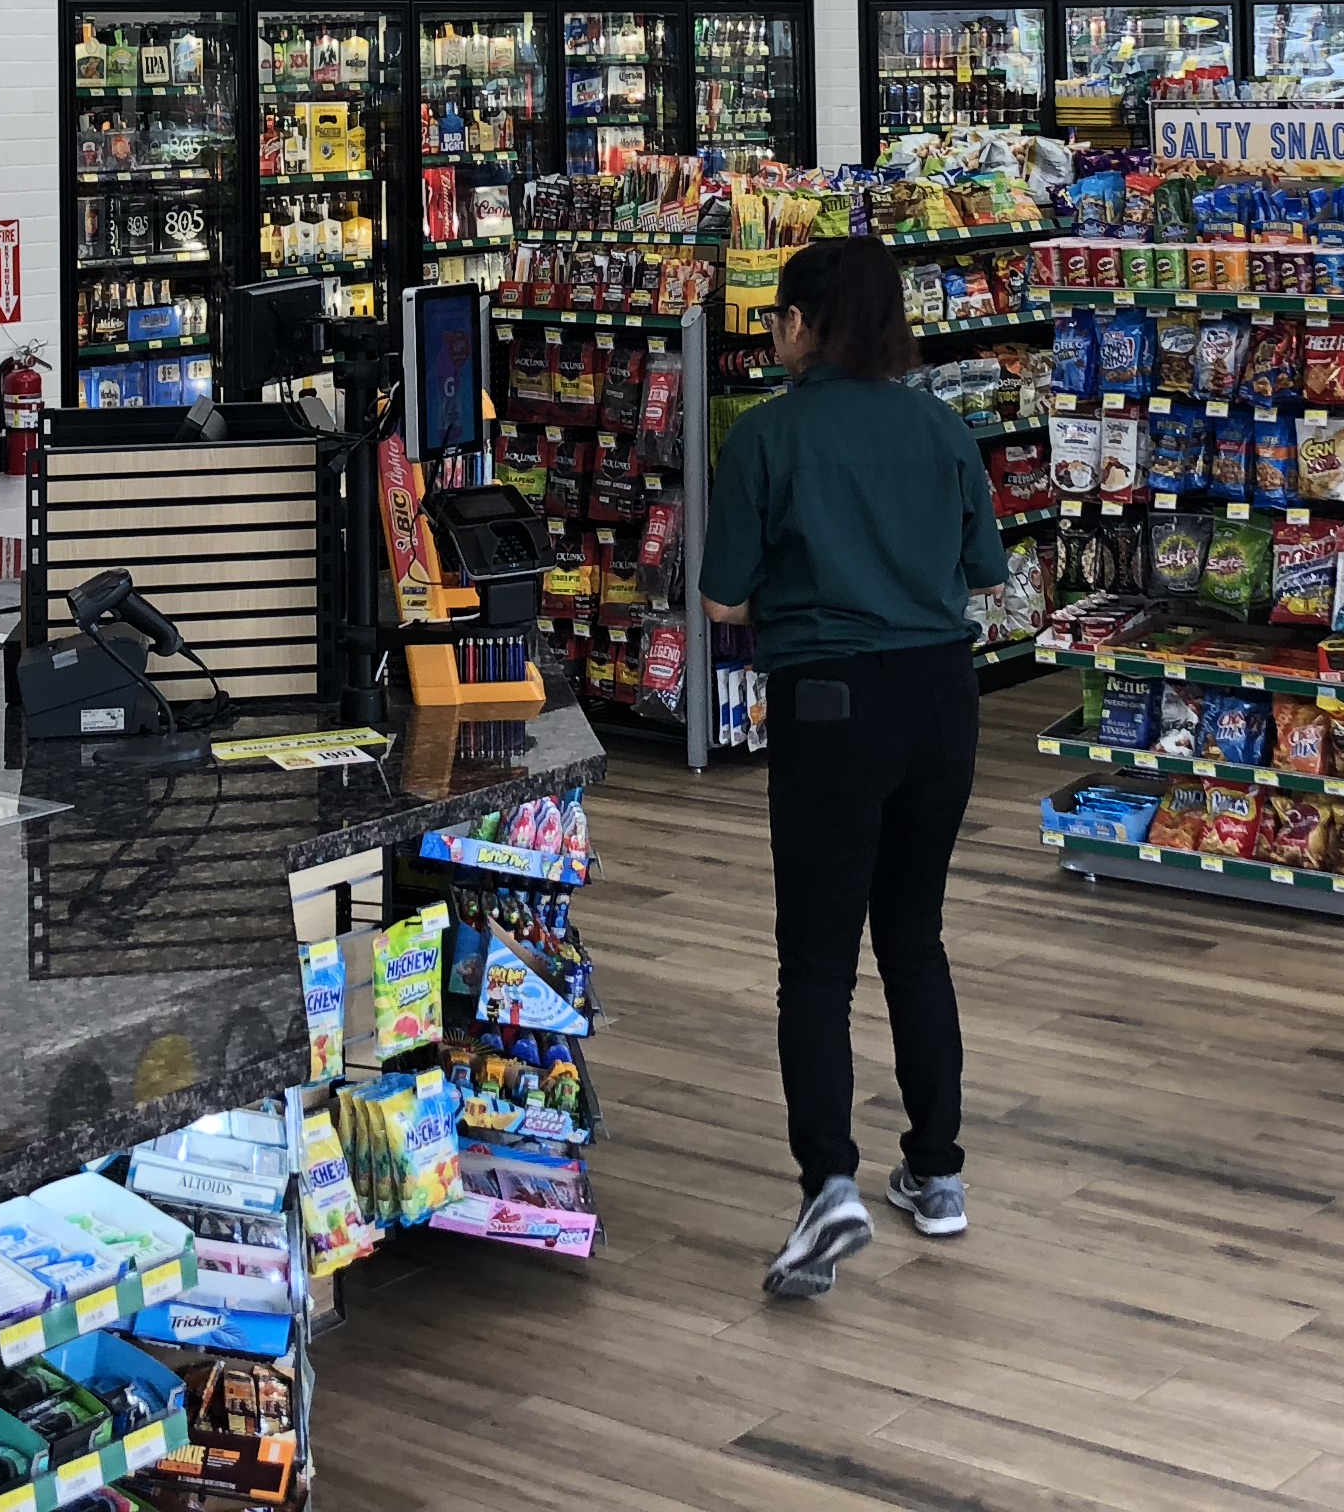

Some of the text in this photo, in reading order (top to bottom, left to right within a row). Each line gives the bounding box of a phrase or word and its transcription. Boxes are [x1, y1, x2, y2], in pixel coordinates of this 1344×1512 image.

[145, 55, 166, 75] IPA
[441, 133, 464, 152] BUD LIGHT
[1162, 122, 1251, 160] SALTY
[127, 216, 148, 232] 805
[165, 210, 204, 235] 805
[1301, 438, 1335, 462] CORN
[390, 492, 412, 533] BIC
[650, 644, 681, 662] LEGEND
[1101, 725, 1138, 739] VINEGAR
[317, 750, 358, 761] 1997
[386, 948, 438, 980] HI-CHEW
[399, 981, 429, 1000] SOURS
[177, 1176, 234, 1196] ALTOIDS
[168, 1313, 223, 1330] Trident
[166, 1445, 206, 1466] OOKIE
